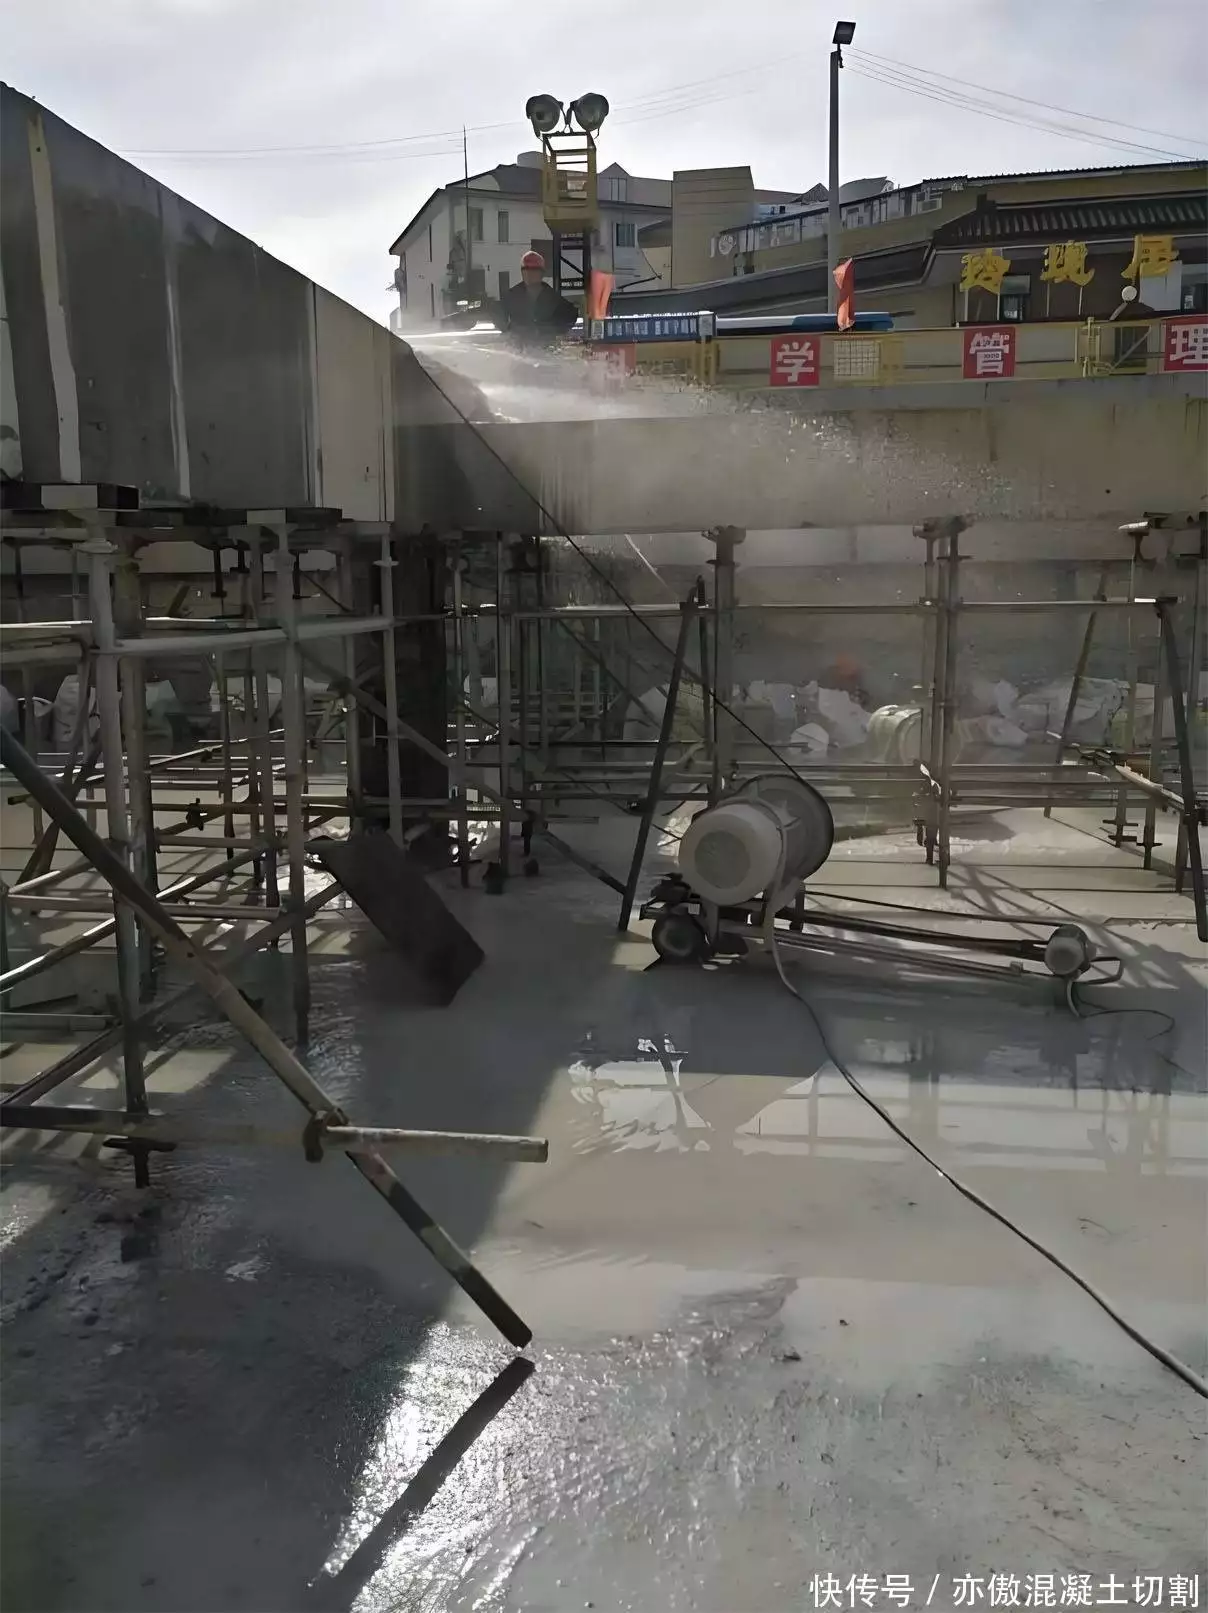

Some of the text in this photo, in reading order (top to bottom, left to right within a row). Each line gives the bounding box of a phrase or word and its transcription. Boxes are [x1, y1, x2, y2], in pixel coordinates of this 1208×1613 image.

[776, 342, 815, 382] 学
[969, 332, 1010, 375] 管
[1169, 323, 1208, 365] 理
